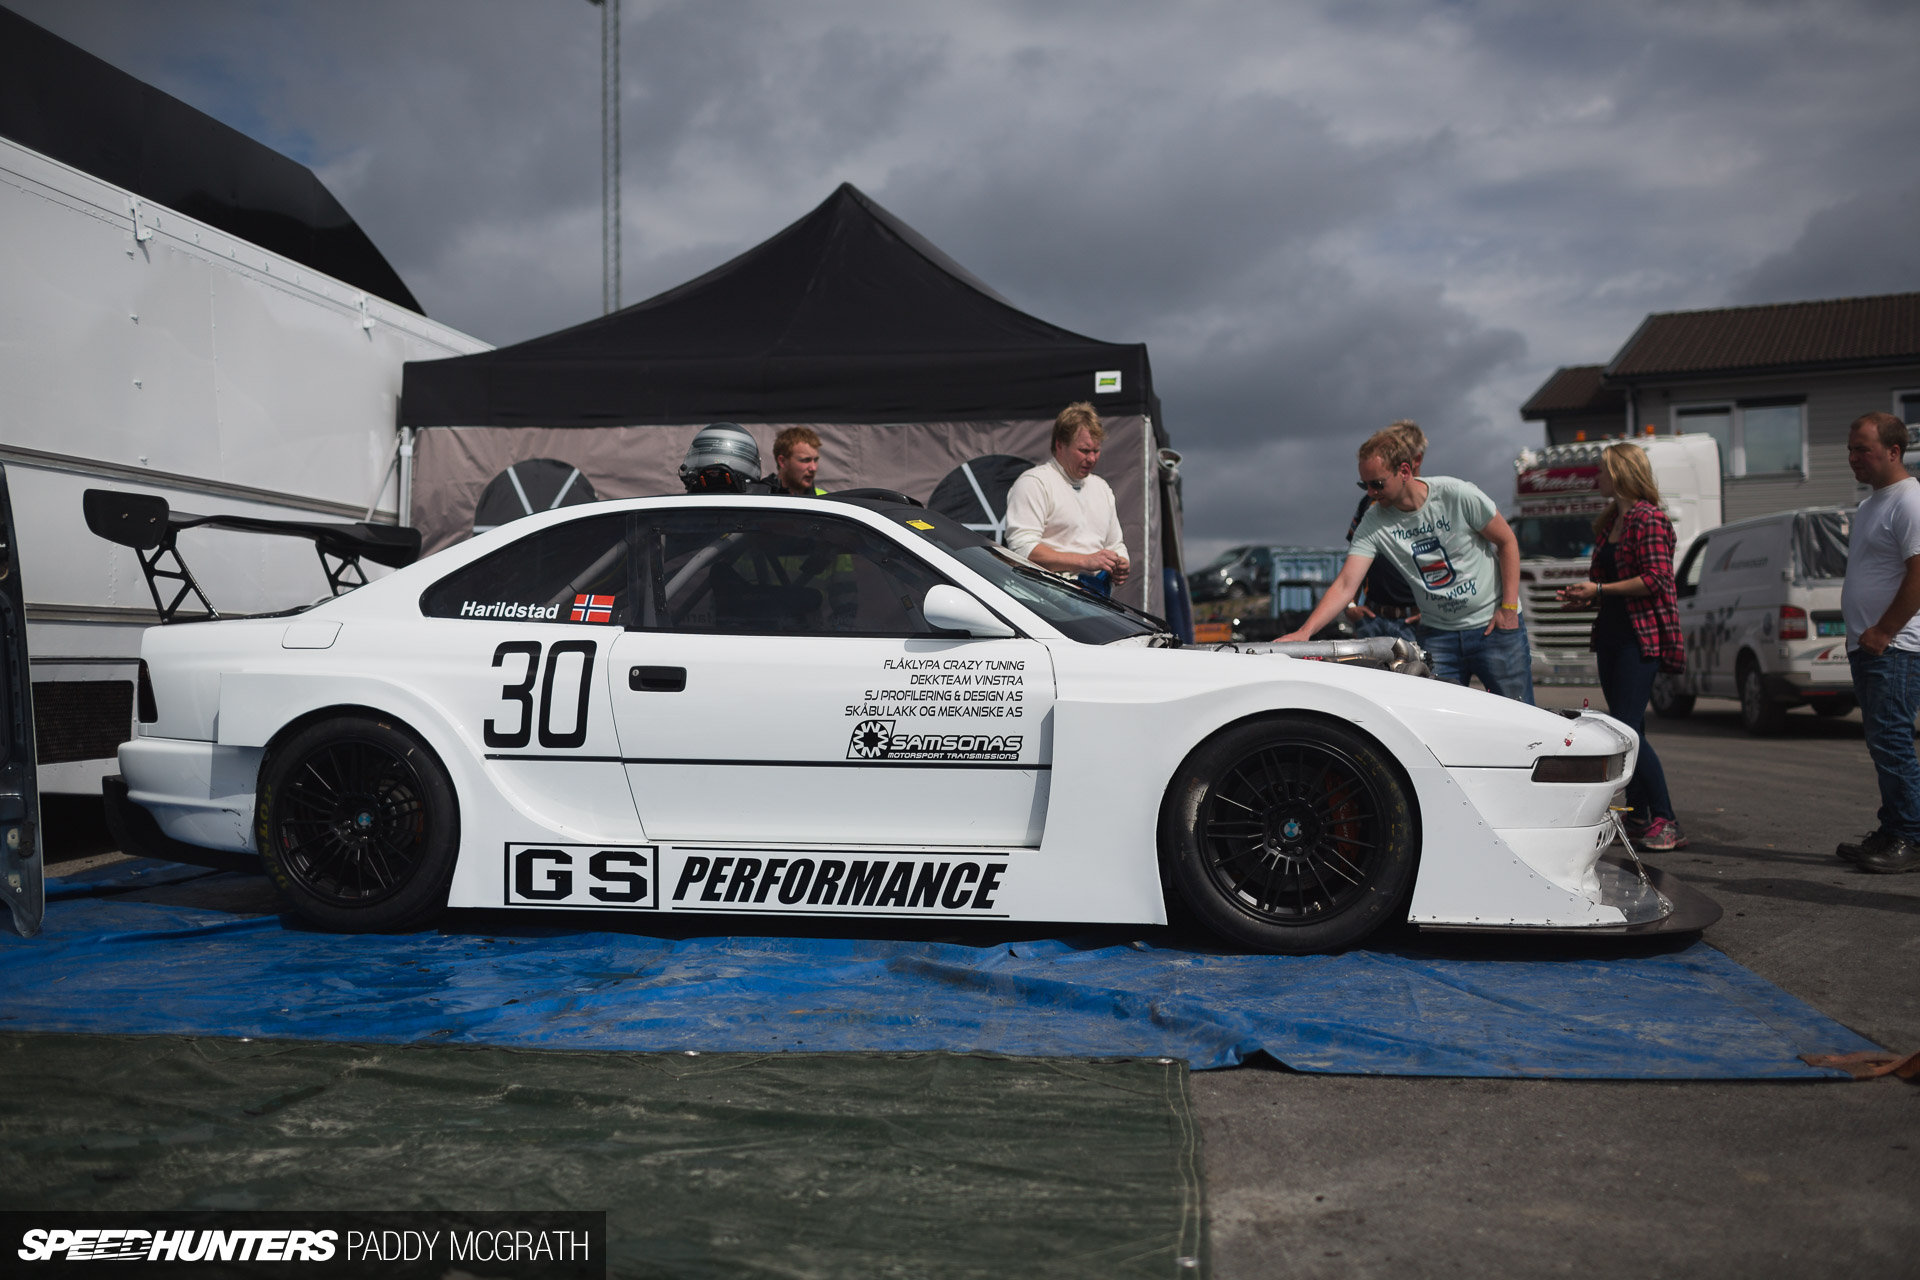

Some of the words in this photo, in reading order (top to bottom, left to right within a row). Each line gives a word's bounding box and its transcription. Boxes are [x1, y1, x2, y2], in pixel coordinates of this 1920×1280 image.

[1436, 515, 1450, 532] of
[460, 601, 560, 620] Harildstad
[884, 657, 941, 670] FLÅKLYPA
[943, 660, 984, 670] CRAZY
[985, 660, 1025, 671] TUNING
[910, 675, 972, 685] DEKKTEAM
[974, 675, 1024, 686] VINSTRA
[484, 640, 598, 748] 30
[864, 690, 880, 701] SJ
[880, 690, 952, 701] PROFILERING
[953, 690, 961, 701] &
[963, 690, 1005, 701] DESIGN
[1005, 691, 1023, 702] AS
[844, 702, 886, 717] SKÅBU
[886, 705, 918, 717] LAKK
[919, 706, 936, 717] OG
[937, 706, 1005, 718] MEKANISKE
[1005, 706, 1023, 718] AS
[890, 736, 1022, 751] SAMSONAS
[887, 752, 945, 760] MOTORSPORT
[947, 752, 1018, 760] TRANSMISSIONS
[672, 856, 1009, 910] PERFORMANCE
